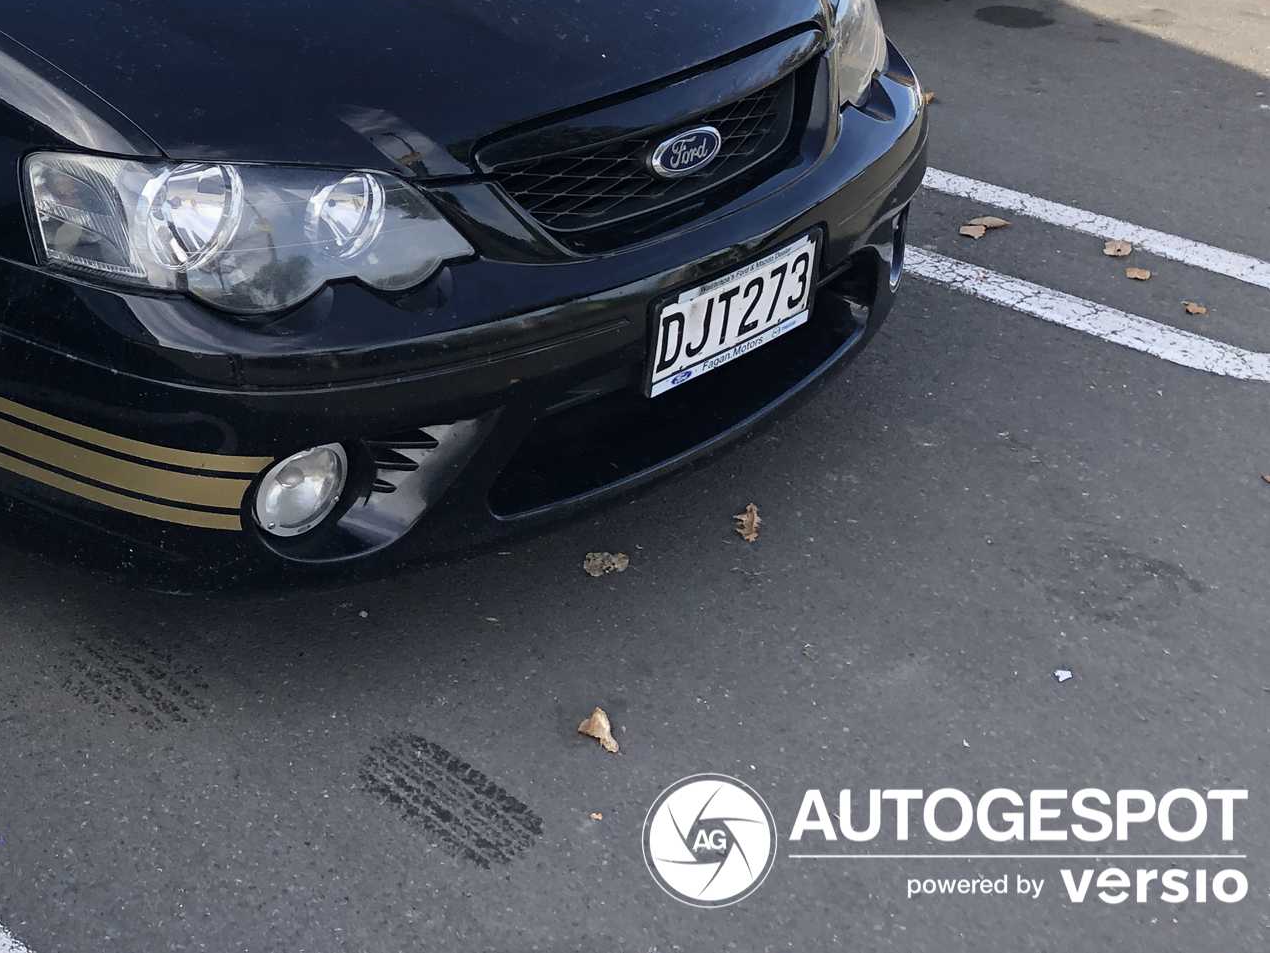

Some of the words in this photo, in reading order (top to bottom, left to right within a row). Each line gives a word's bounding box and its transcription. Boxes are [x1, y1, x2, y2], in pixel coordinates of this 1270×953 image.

[670, 135, 708, 168] Ford
[656, 252, 810, 373] DJT273
[732, 337, 763, 357] Motors
